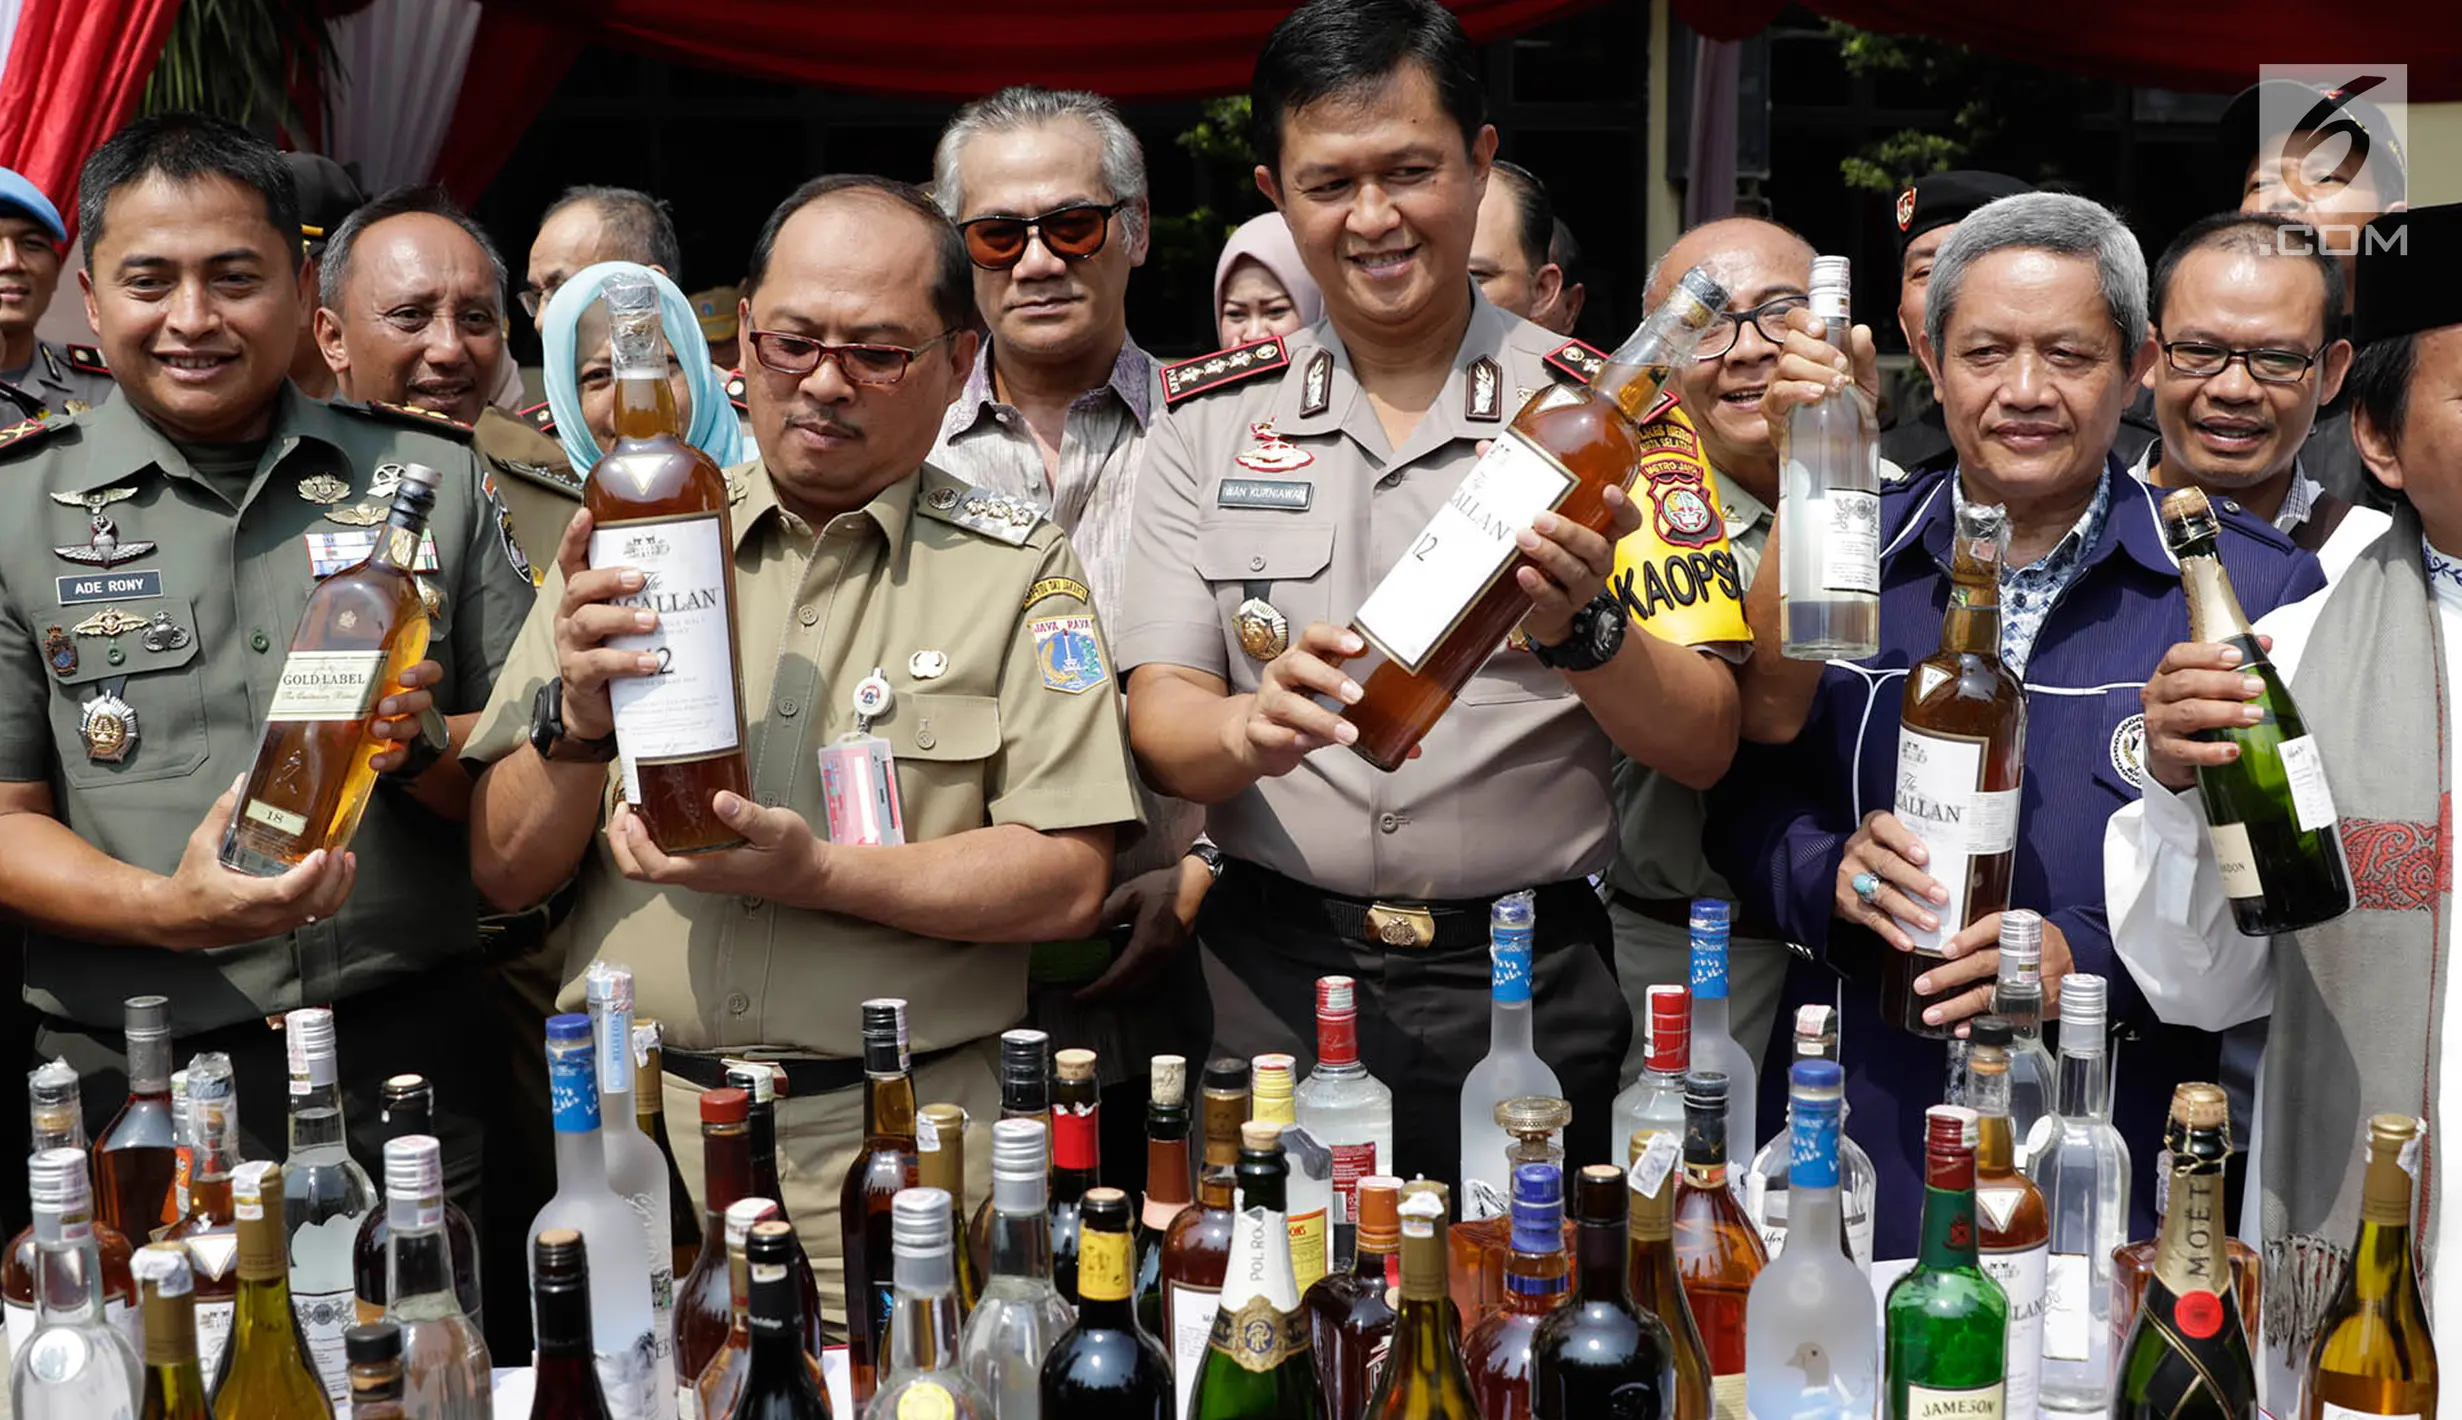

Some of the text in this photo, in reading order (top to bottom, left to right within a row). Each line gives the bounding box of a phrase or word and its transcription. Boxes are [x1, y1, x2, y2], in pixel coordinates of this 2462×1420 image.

[1645, 461, 1677, 475] METRO
[1222, 486, 1307, 500] IWAN KURNIAWAN
[1412, 532, 1438, 562] 12
[75, 578, 144, 595] ADE RONY
[283, 673, 366, 686] GOLD LABEL
[266, 811, 284, 824] 18
[1250, 1251, 1264, 1282] POL
[1922, 1400, 1996, 1418] JAMESON
